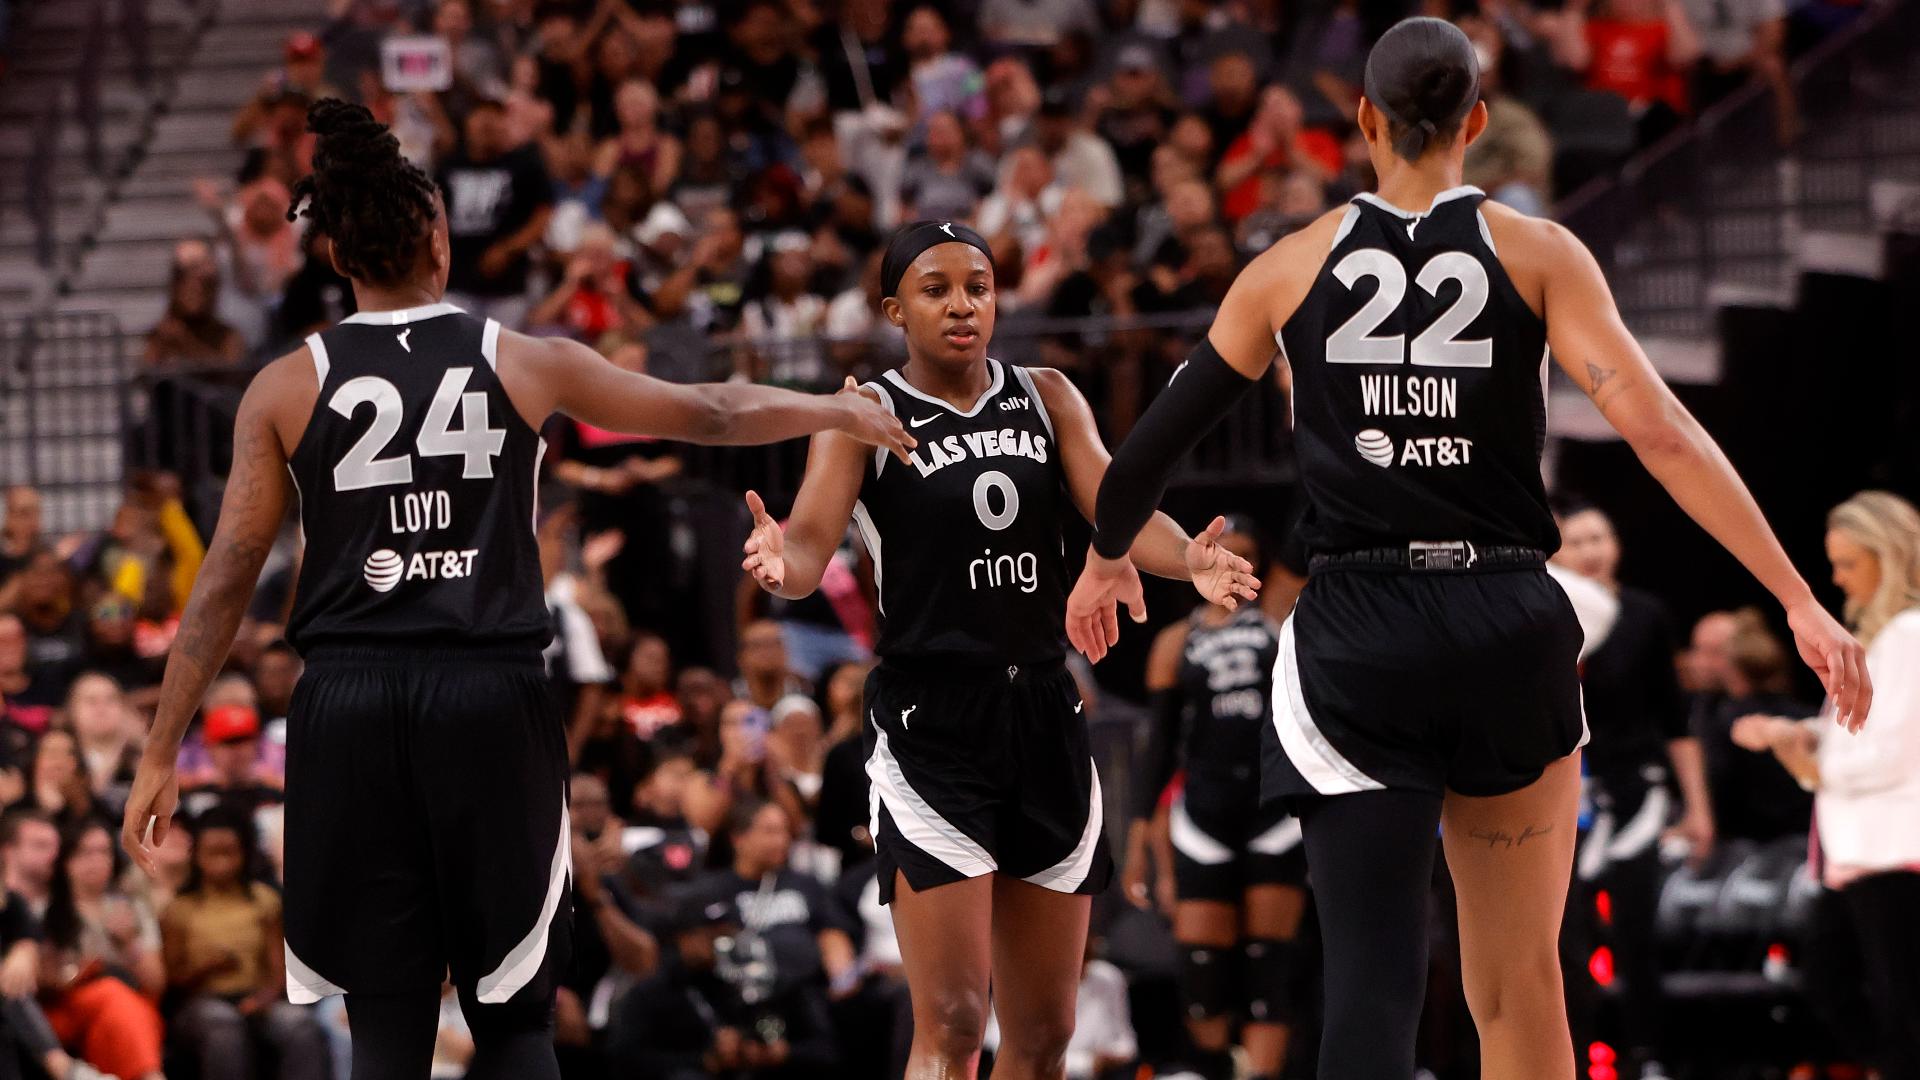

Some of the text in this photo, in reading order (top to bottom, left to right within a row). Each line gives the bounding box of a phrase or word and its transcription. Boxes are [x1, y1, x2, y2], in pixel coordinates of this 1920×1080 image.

[1326, 248, 1493, 368] 22
[1000, 396, 1029, 411] ally
[1360, 374, 1457, 418] WILSON
[328, 367, 507, 491] 24
[909, 428, 1048, 478] LAS VEGAS
[1400, 436, 1473, 467] AT&T
[390, 490, 450, 533] LOYD
[973, 470, 1019, 530] 0
[406, 549, 478, 581] AT&T
[969, 548, 1038, 593] ring
